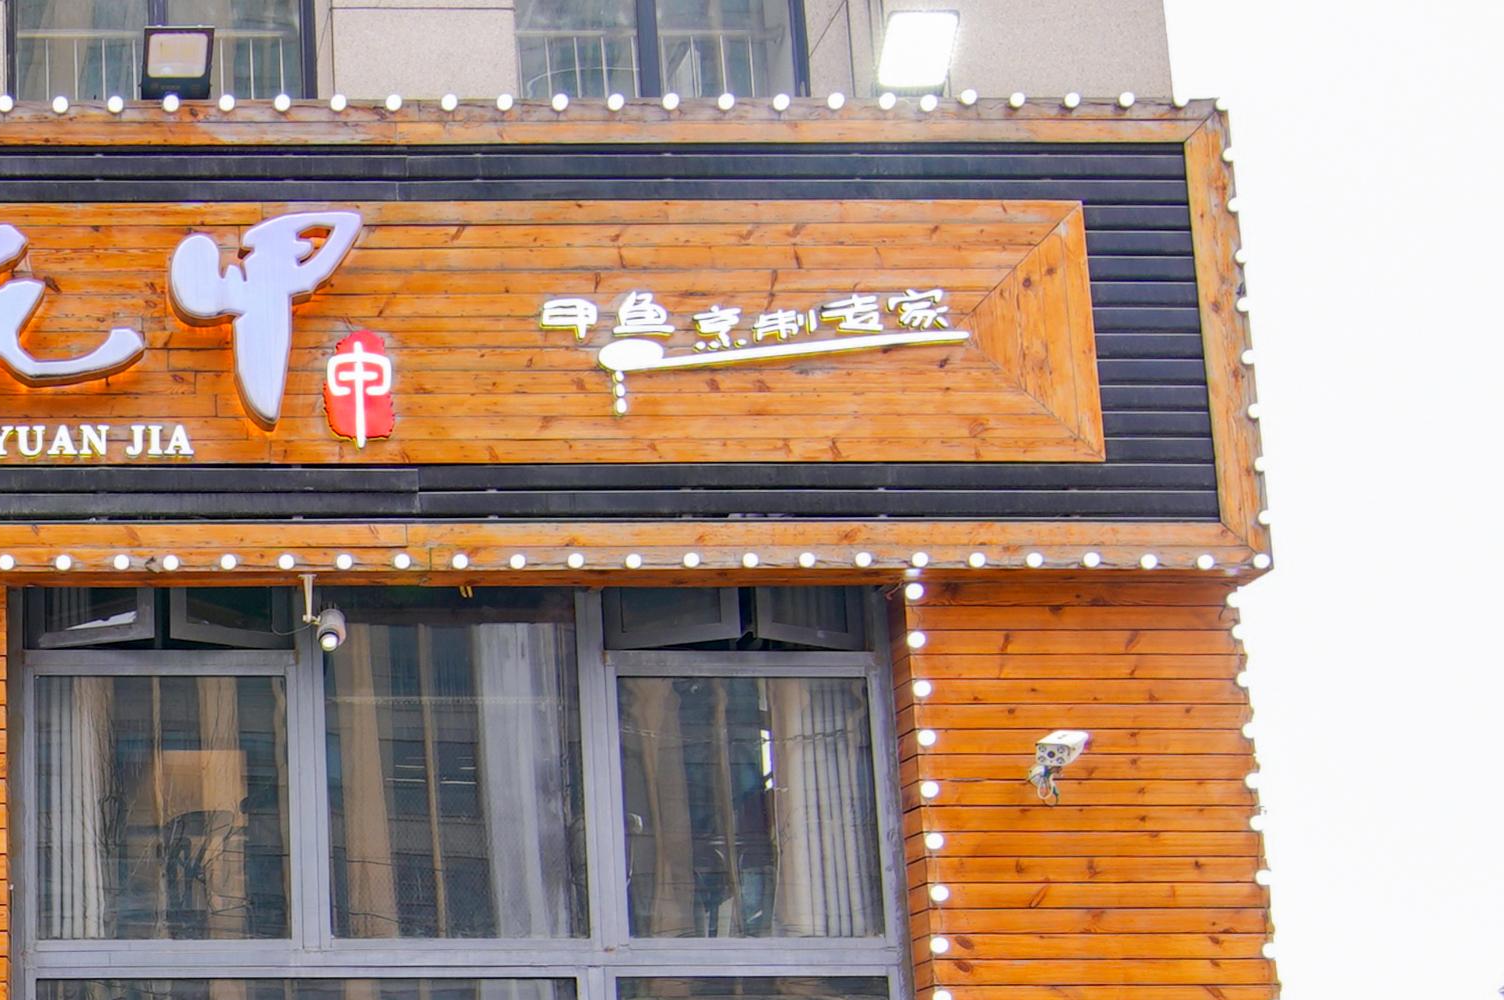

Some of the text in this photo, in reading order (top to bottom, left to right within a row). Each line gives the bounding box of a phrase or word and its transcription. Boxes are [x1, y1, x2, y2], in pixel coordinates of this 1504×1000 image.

[540, 289, 951, 352] 甲鱼烹制专家
[125, 424, 195, 458] JIA
